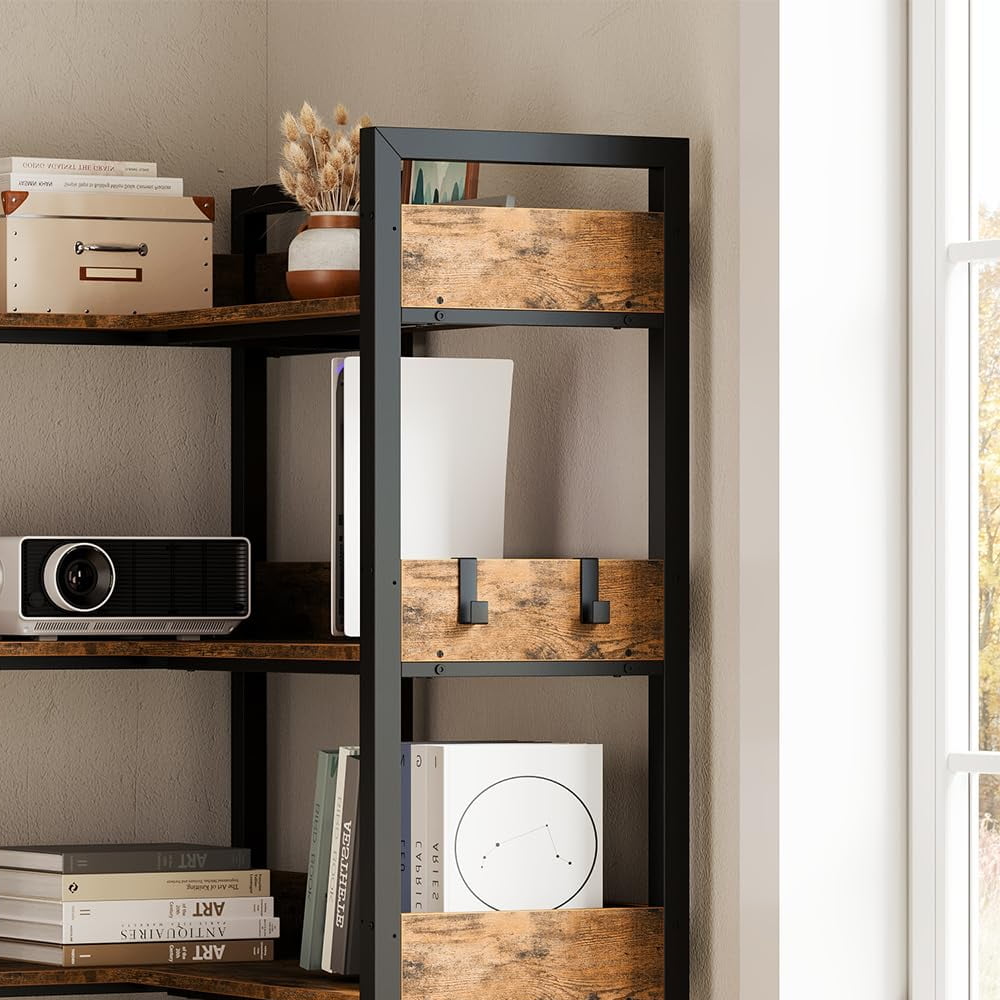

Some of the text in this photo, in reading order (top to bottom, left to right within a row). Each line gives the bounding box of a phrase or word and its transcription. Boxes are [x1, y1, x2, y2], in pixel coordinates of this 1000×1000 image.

[192, 902, 226, 917] ART
[120, 925, 227, 940] ANTIQUAIRES
[192, 944, 226, 961] ART
